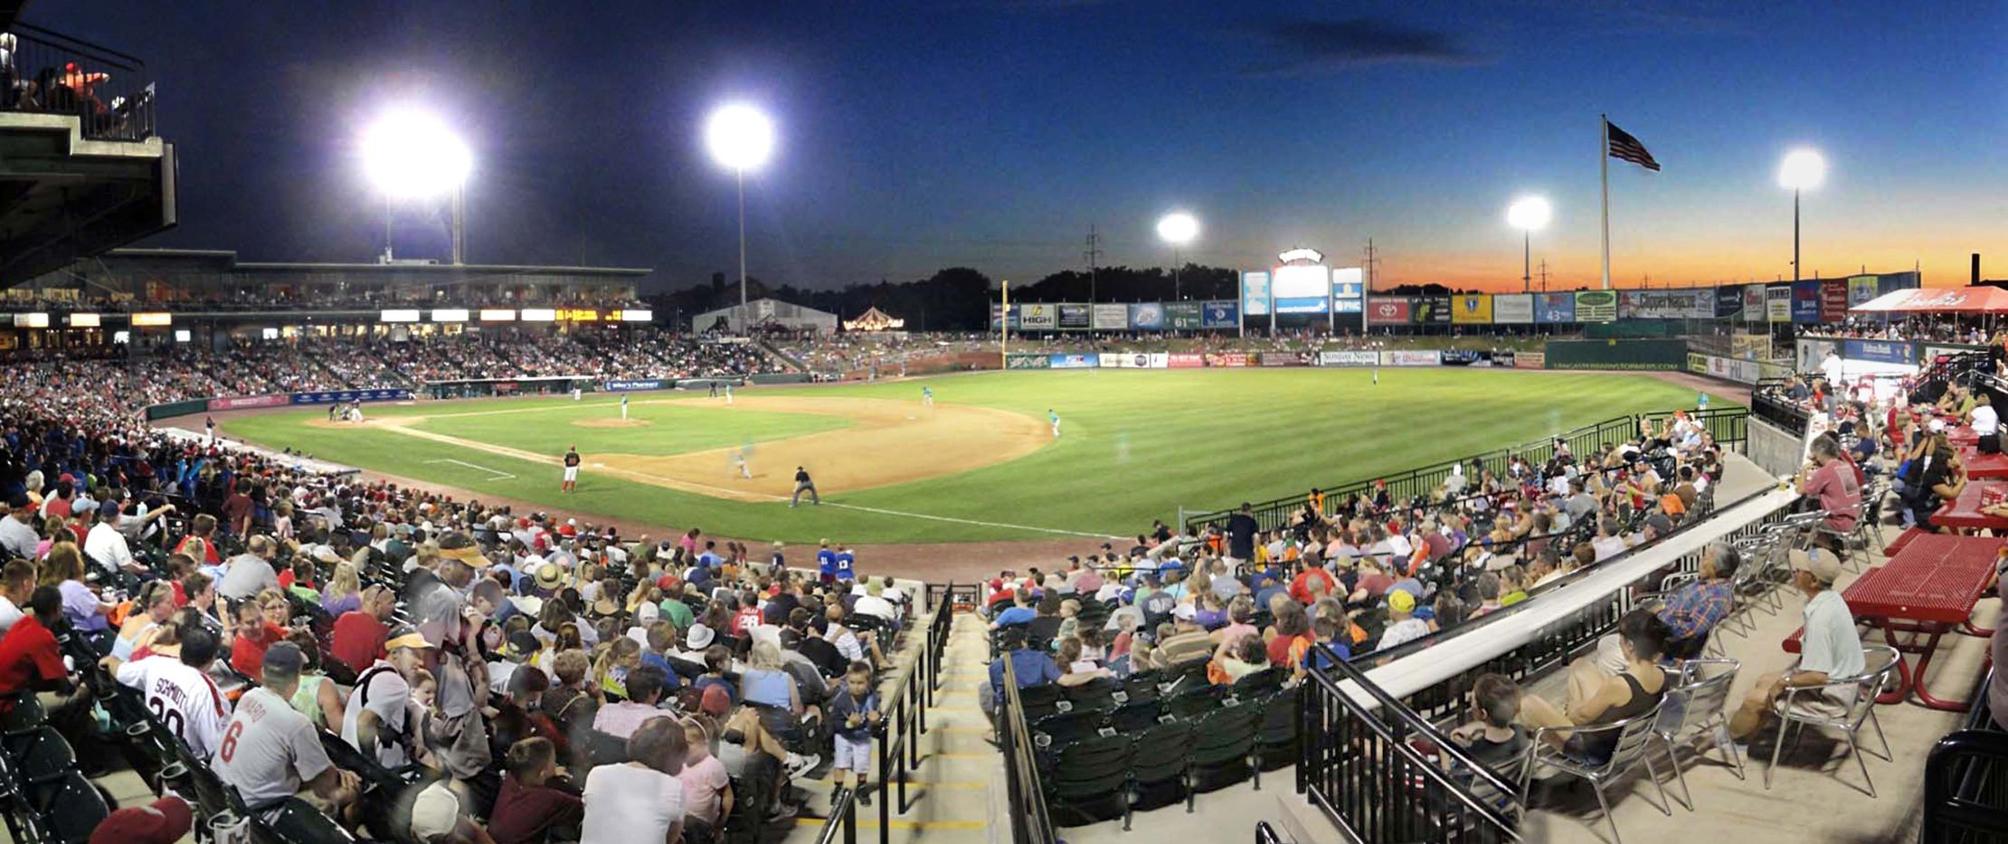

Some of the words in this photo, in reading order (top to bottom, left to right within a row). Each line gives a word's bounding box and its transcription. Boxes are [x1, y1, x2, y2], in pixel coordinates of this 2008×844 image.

[1023, 316, 1052, 324] HIGH
[1546, 310, 1560, 321] 43
[1174, 317, 1188, 328] 61
[154, 677, 187, 710] SCHMIDT
[220, 720, 243, 763] 6
